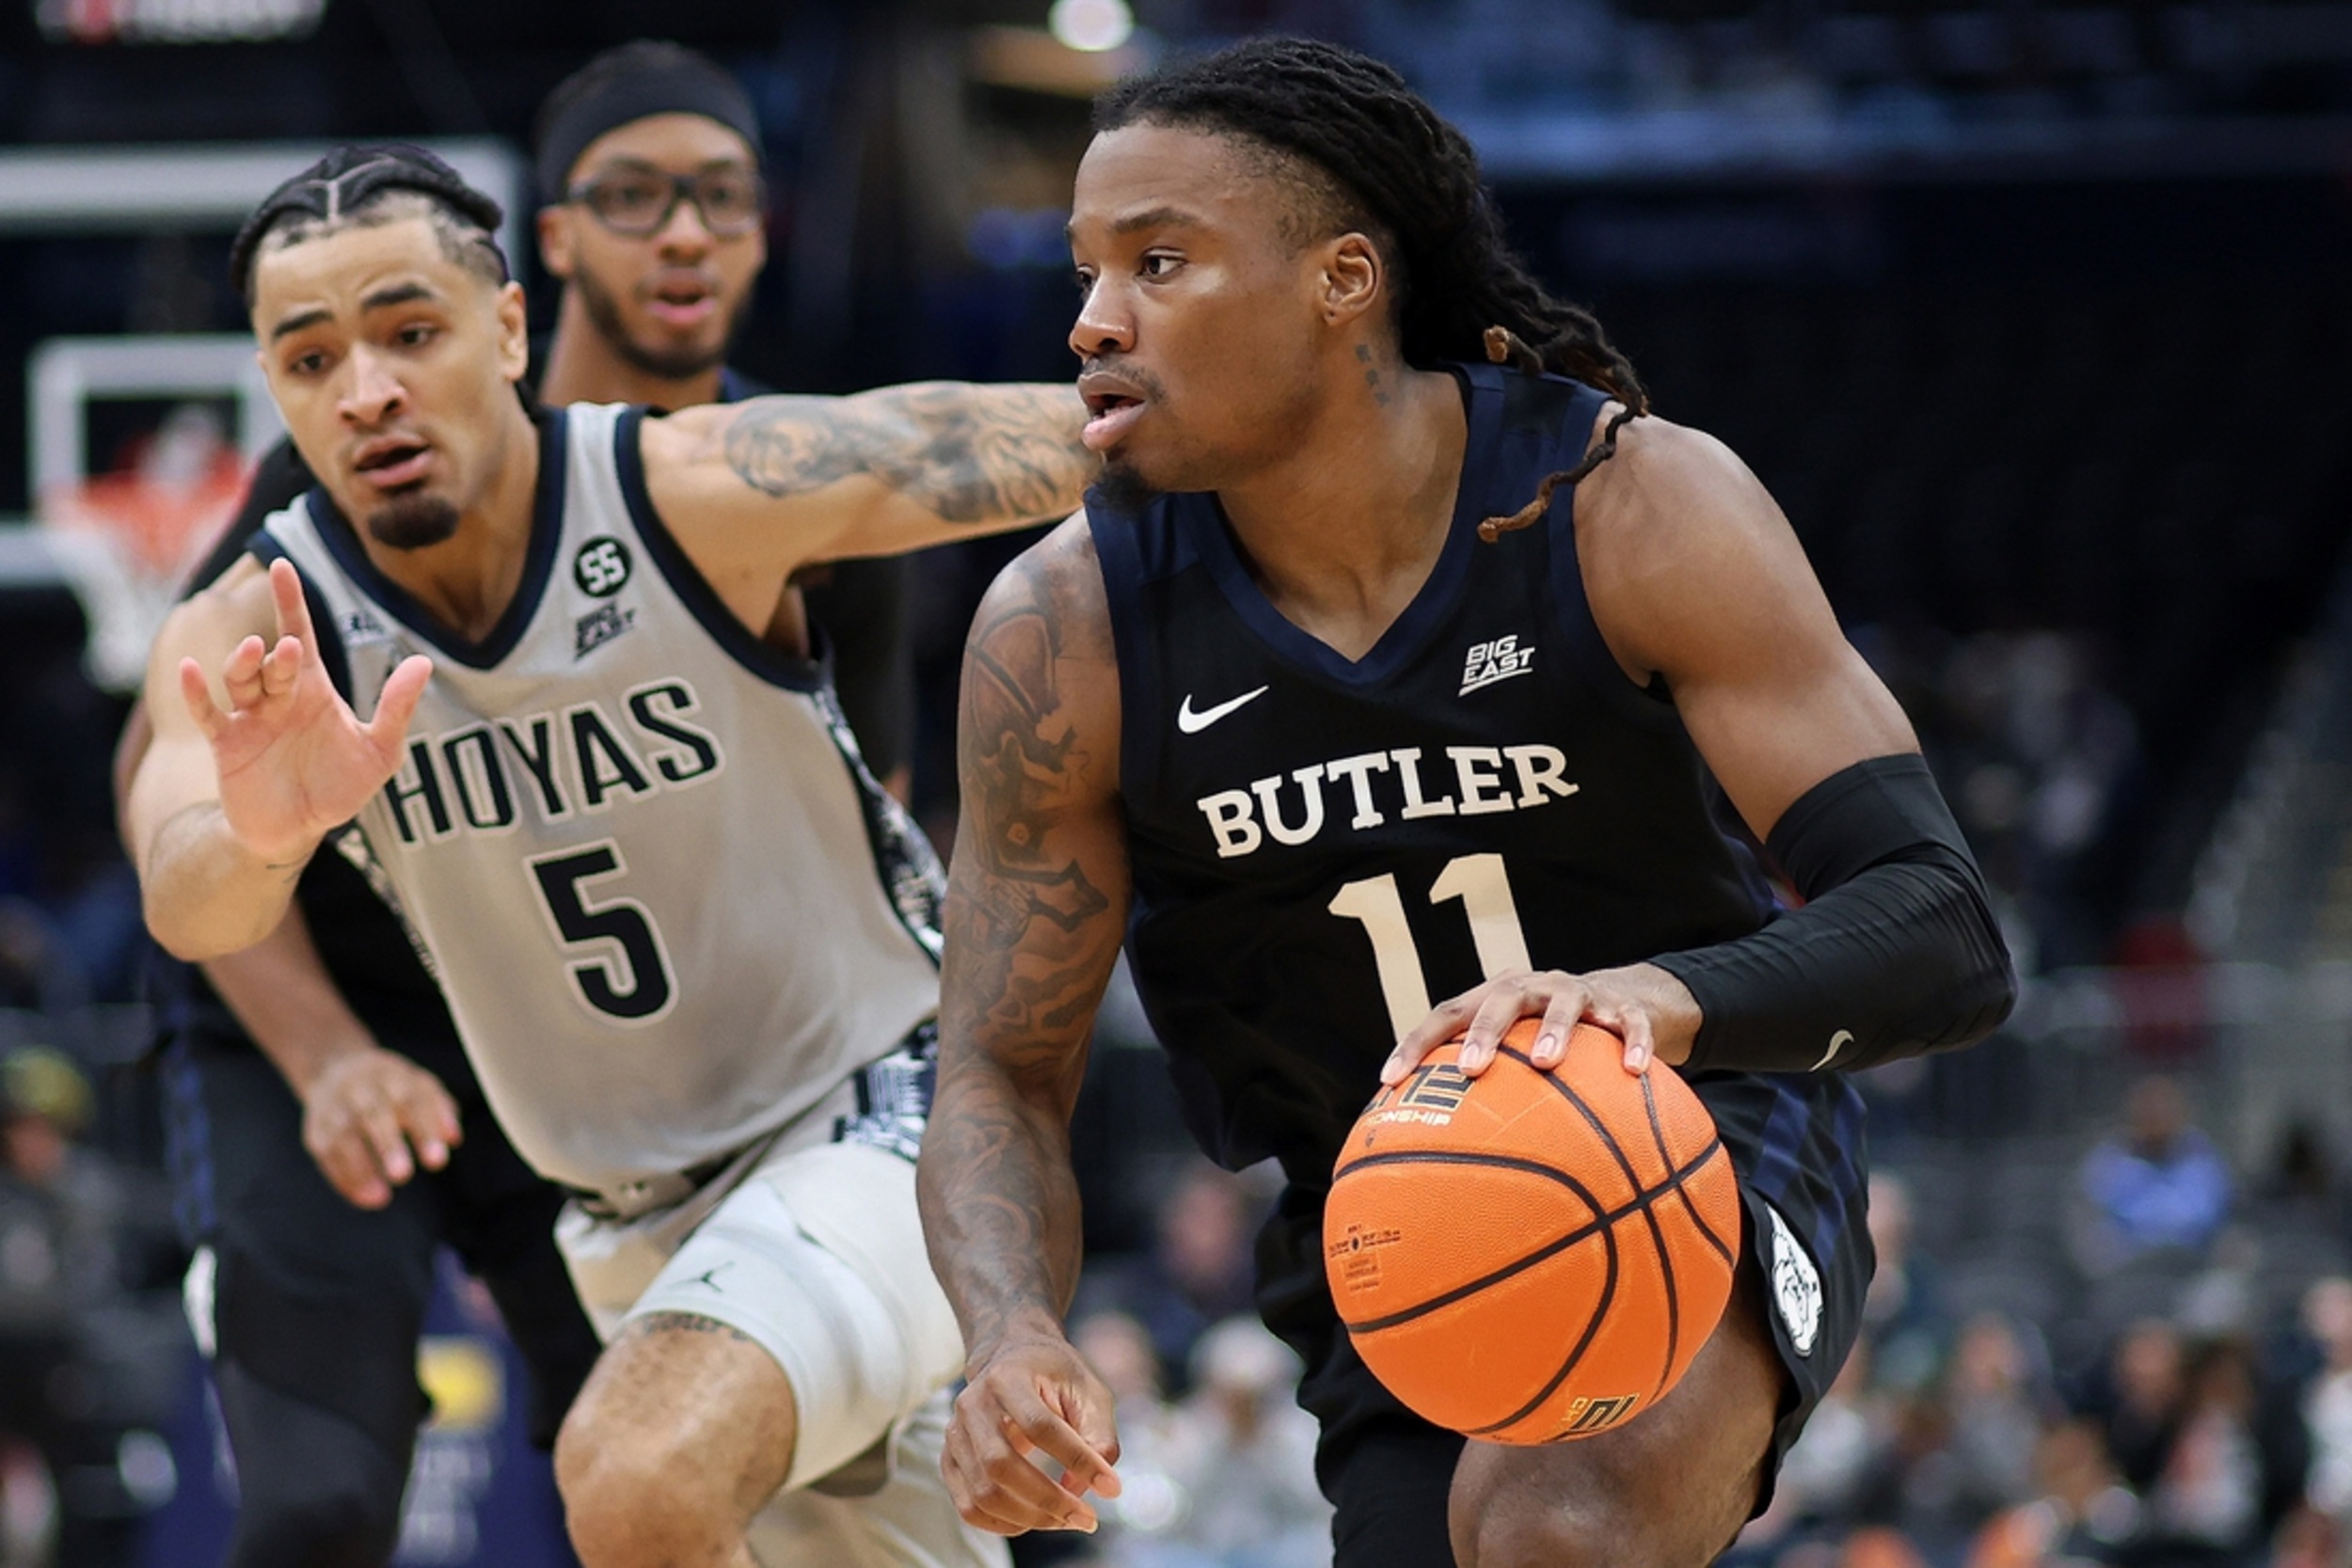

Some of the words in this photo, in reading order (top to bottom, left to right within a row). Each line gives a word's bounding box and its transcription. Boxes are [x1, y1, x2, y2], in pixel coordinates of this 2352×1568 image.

[1461, 646, 1536, 685] EAST
[1465, 634, 1518, 666] BIG
[383, 681, 723, 847] HOYAS
[1196, 743, 1580, 860] BUTLER
[526, 841, 677, 1026] 5
[1327, 852, 1534, 1046] 11
